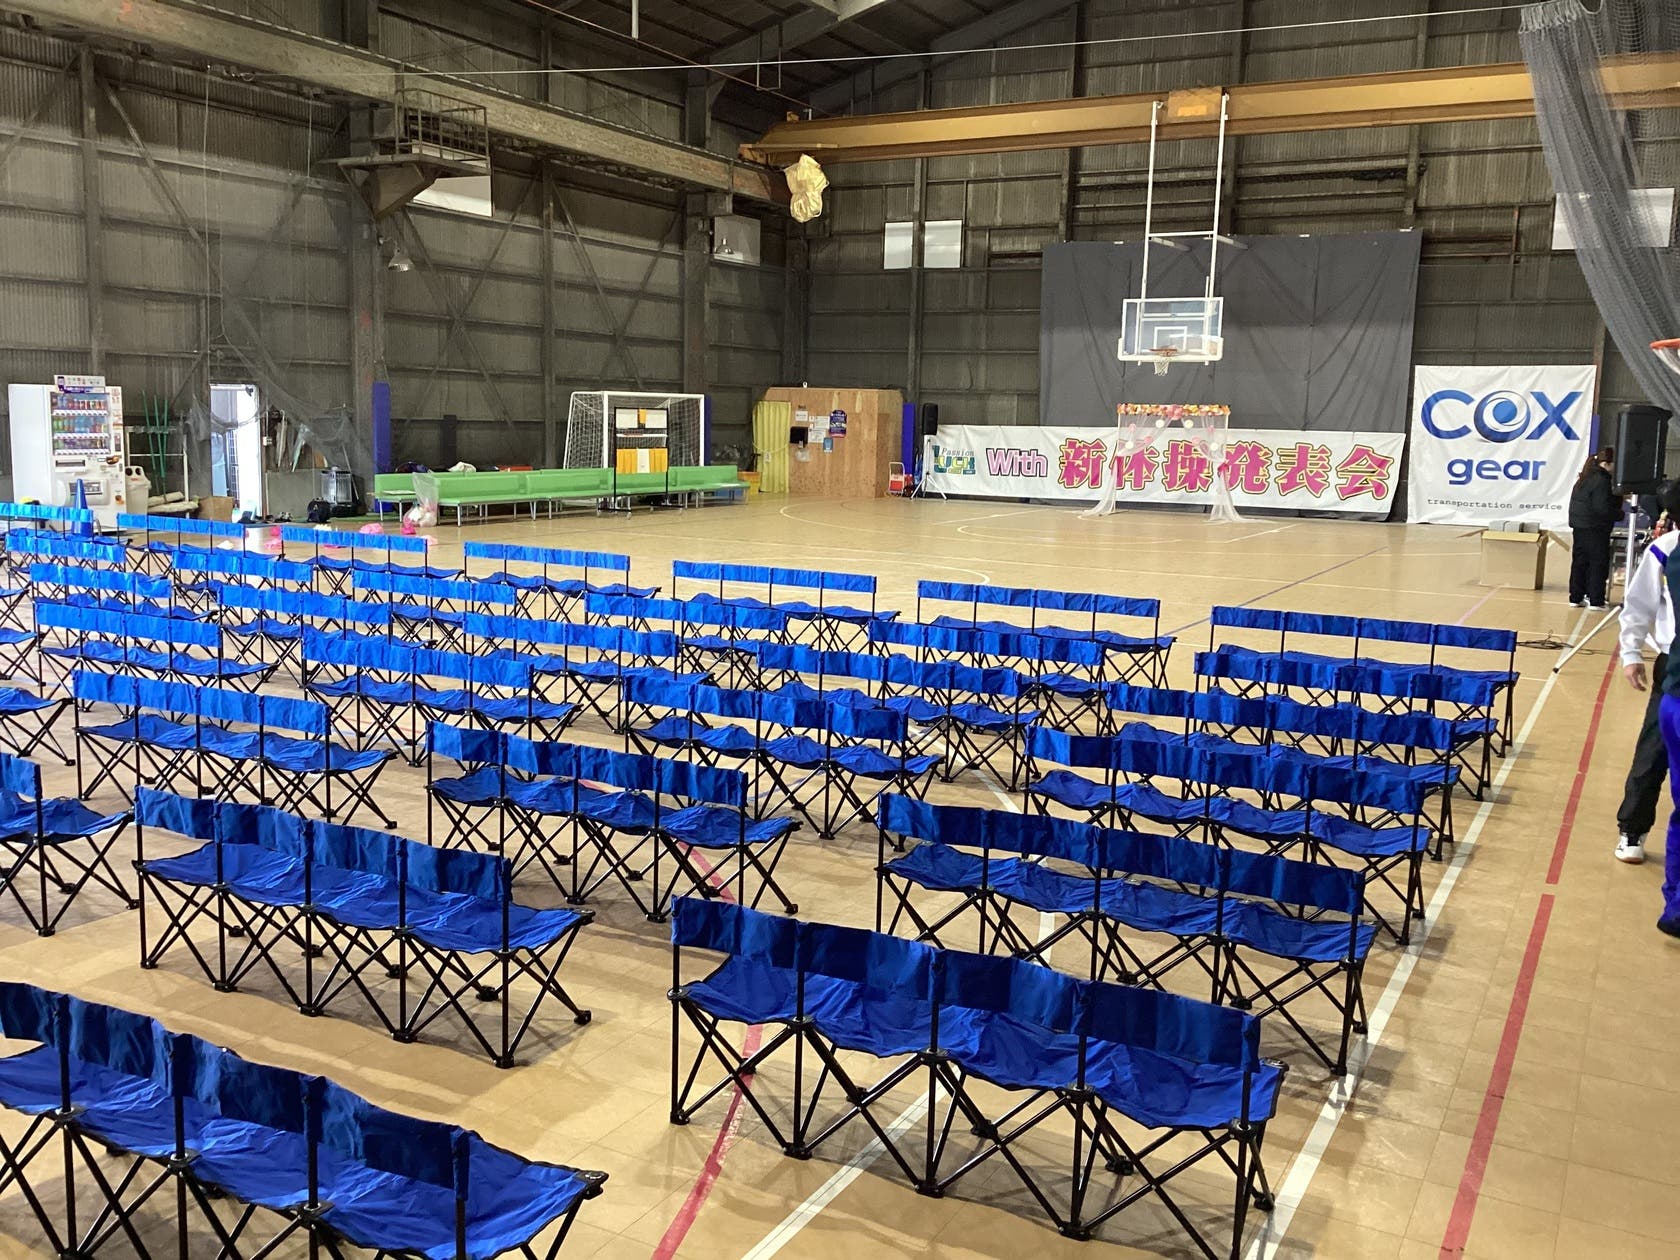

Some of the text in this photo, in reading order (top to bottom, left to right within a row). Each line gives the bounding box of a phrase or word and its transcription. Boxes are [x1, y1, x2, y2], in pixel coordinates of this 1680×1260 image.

[1421, 389, 1583, 442] COX
[942, 448, 975, 457] Passion
[985, 437, 1394, 501] With 新体操発表会
[1447, 458, 1546, 485] gear
[1427, 498, 1562, 510] transportation service
